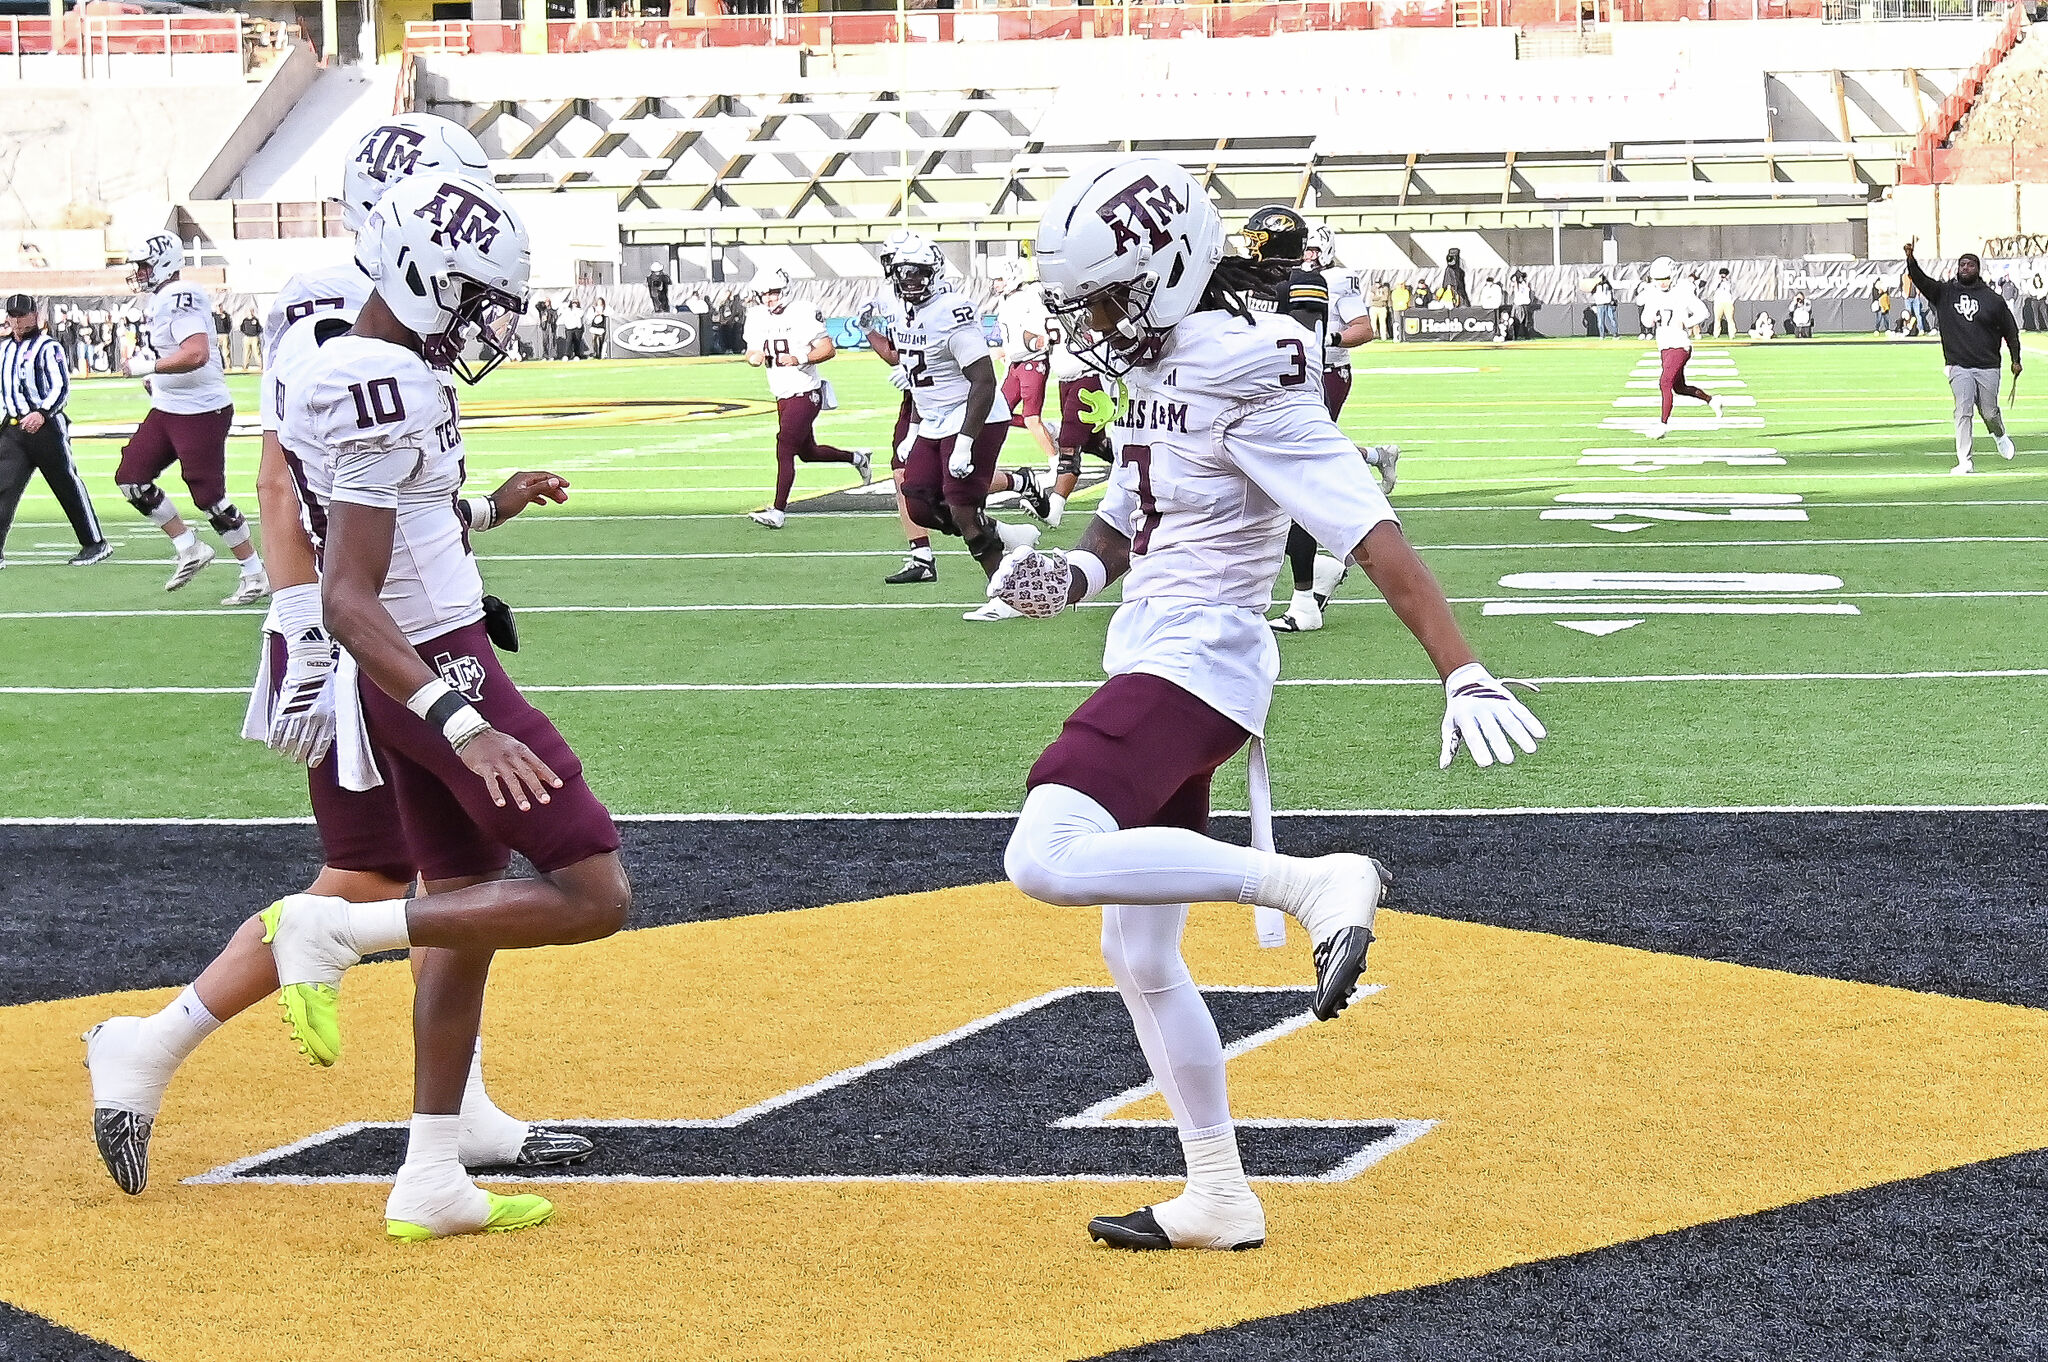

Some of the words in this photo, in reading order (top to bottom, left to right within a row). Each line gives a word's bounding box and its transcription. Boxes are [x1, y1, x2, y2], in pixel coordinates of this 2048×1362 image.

[172, 292, 193, 308] 73
[952, 306, 974, 324] 52
[1421, 317, 1463, 333] Health
[1463, 317, 1495, 332] Care
[1276, 338, 1306, 385] 3
[347, 376, 406, 429] 10
[1150, 400, 1188, 434] A&M
